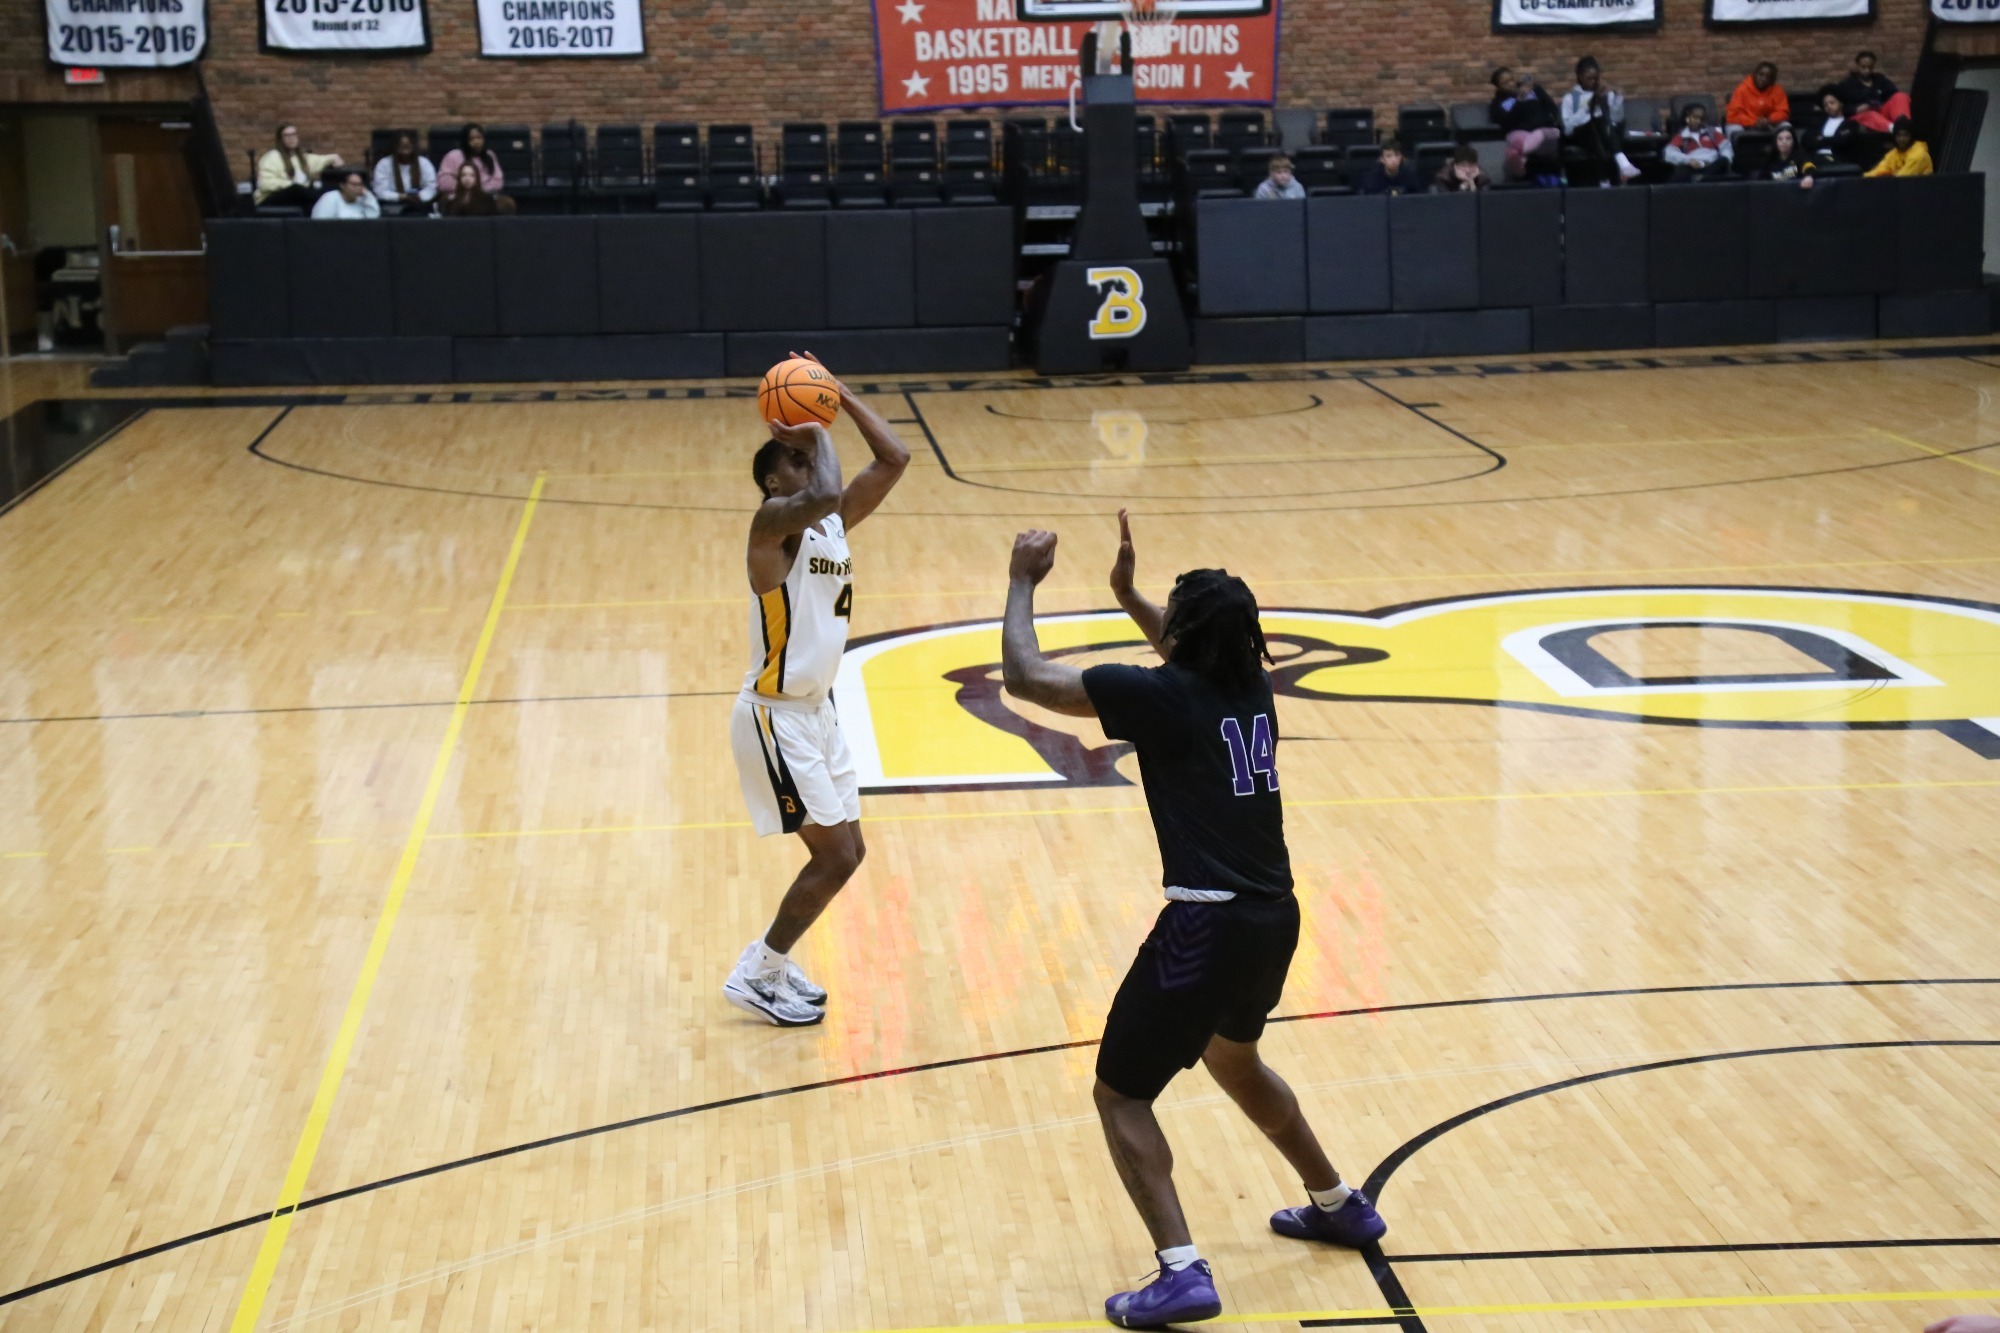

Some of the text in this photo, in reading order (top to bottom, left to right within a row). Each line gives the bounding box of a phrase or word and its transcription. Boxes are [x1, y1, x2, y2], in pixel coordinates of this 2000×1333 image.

[365, 19, 379, 31] 32
[502, 0, 616, 21] CHAMPIONS
[60, 24, 197, 53] 2015-2016
[508, 25, 614, 48] 2016-2017
[914, 26, 1079, 62] BASKETBALL
[946, 63, 1009, 95] 1995
[1086, 266, 1148, 340] B
[833, 583, 853, 624] 4
[1220, 713, 1280, 797] 14
